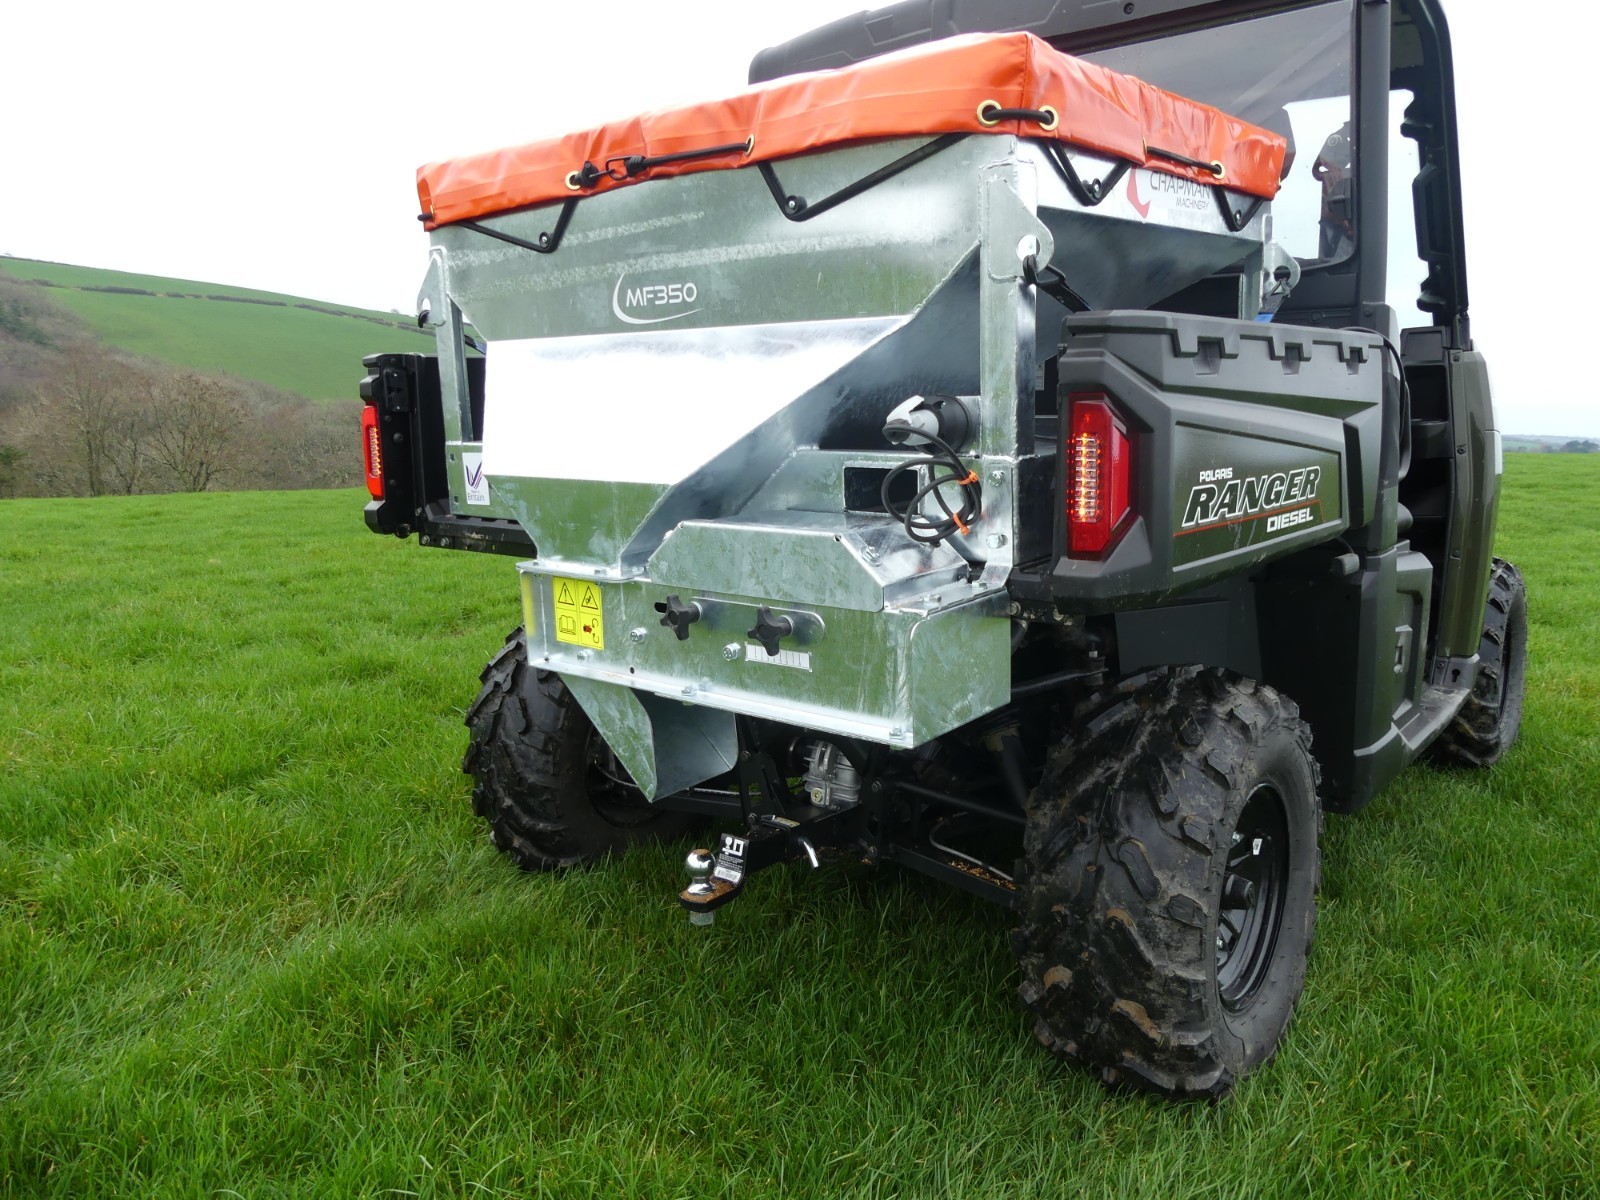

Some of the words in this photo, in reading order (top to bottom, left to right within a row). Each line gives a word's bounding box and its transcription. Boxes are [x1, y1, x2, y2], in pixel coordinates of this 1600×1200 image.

[1150, 171, 1211, 199] CHAPMAN
[1176, 197, 1209, 210] MACHINERY
[626, 282, 697, 307] MF350
[1200, 467, 1233, 482] POLARIS
[1181, 465, 1321, 527] RANGER
[1266, 507, 1314, 533] DIESEL
